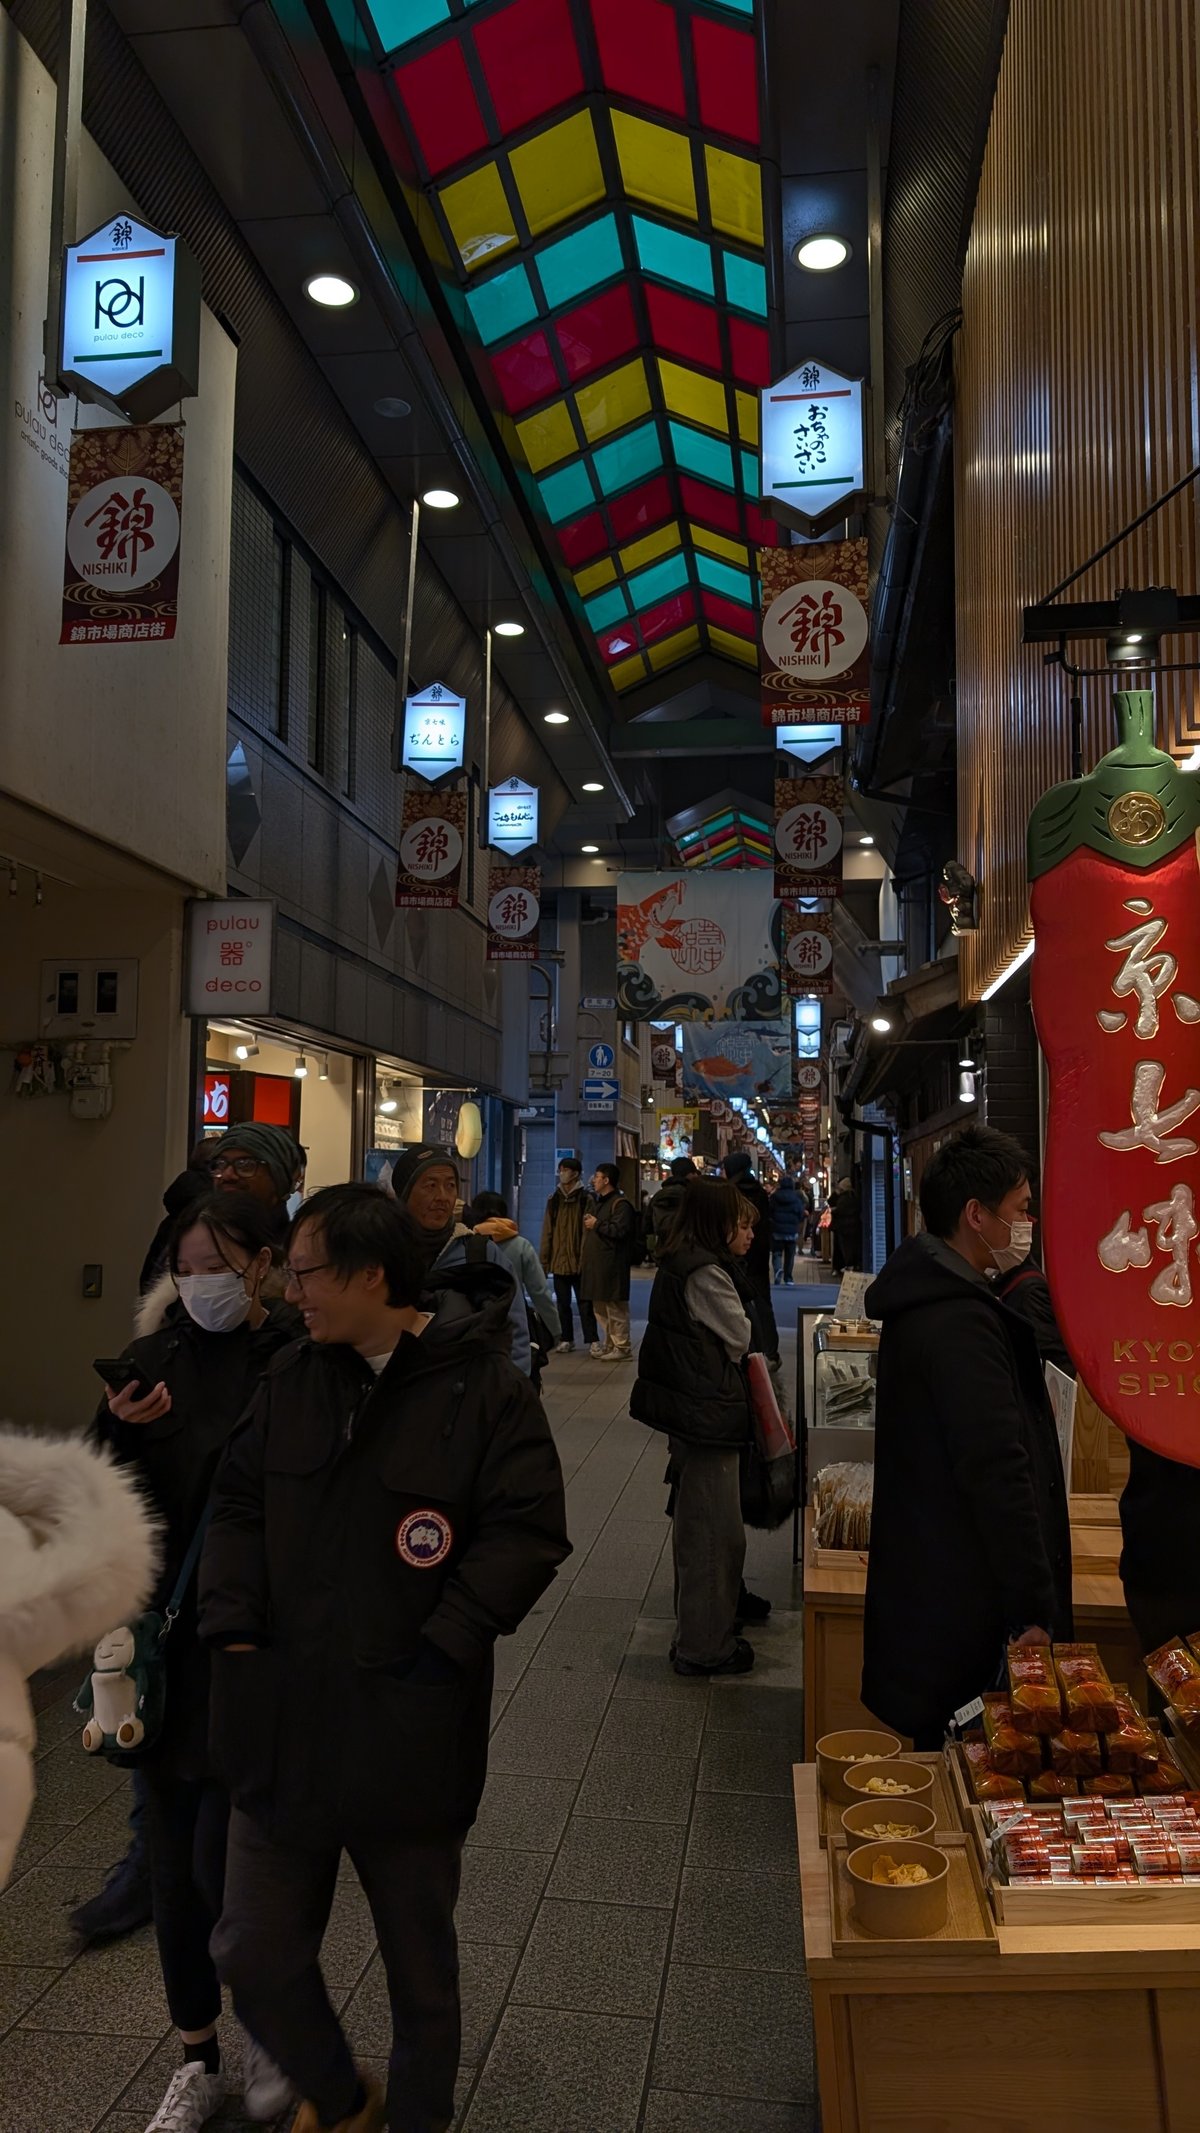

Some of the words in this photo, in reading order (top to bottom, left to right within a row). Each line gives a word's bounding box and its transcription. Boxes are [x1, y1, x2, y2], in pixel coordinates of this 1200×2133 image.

[108, 220, 134, 250] 錦
[93, 333, 118, 342] pulau
[121, 331, 144, 340] deco
[798, 366, 820, 391] 錦
[15, 399, 46, 440] pulau
[808, 404, 830, 463] おちゃのこ
[793, 424, 816, 474] さいさい
[84, 487, 155, 577] 錦
[82, 562, 128, 576] NISHIKI
[69, 620, 166, 642] 錦市場商店街
[777, 590, 845, 669] 錦
[778, 654, 822, 667] NISHIKI
[770, 706, 861, 724] 錦市場商店街
[409, 733, 460, 746] ぢんとら
[409, 825, 449, 872] 錦
[785, 811, 828, 861] 錦
[785, 852, 812, 860] NISHIKI
[400, 895, 453, 907] 錦市場商店街
[779, 886, 837, 897] 錦市場商店街
[206, 915, 259, 935] pulau
[495, 893, 528, 932] 錦
[793, 936, 823, 969] 錦
[205, 977, 262, 992] deco
[204, 1080, 228, 1118] ち
[1095, 895, 1200, 1307] 京七味
[1113, 1338, 1200, 1362] KYO
